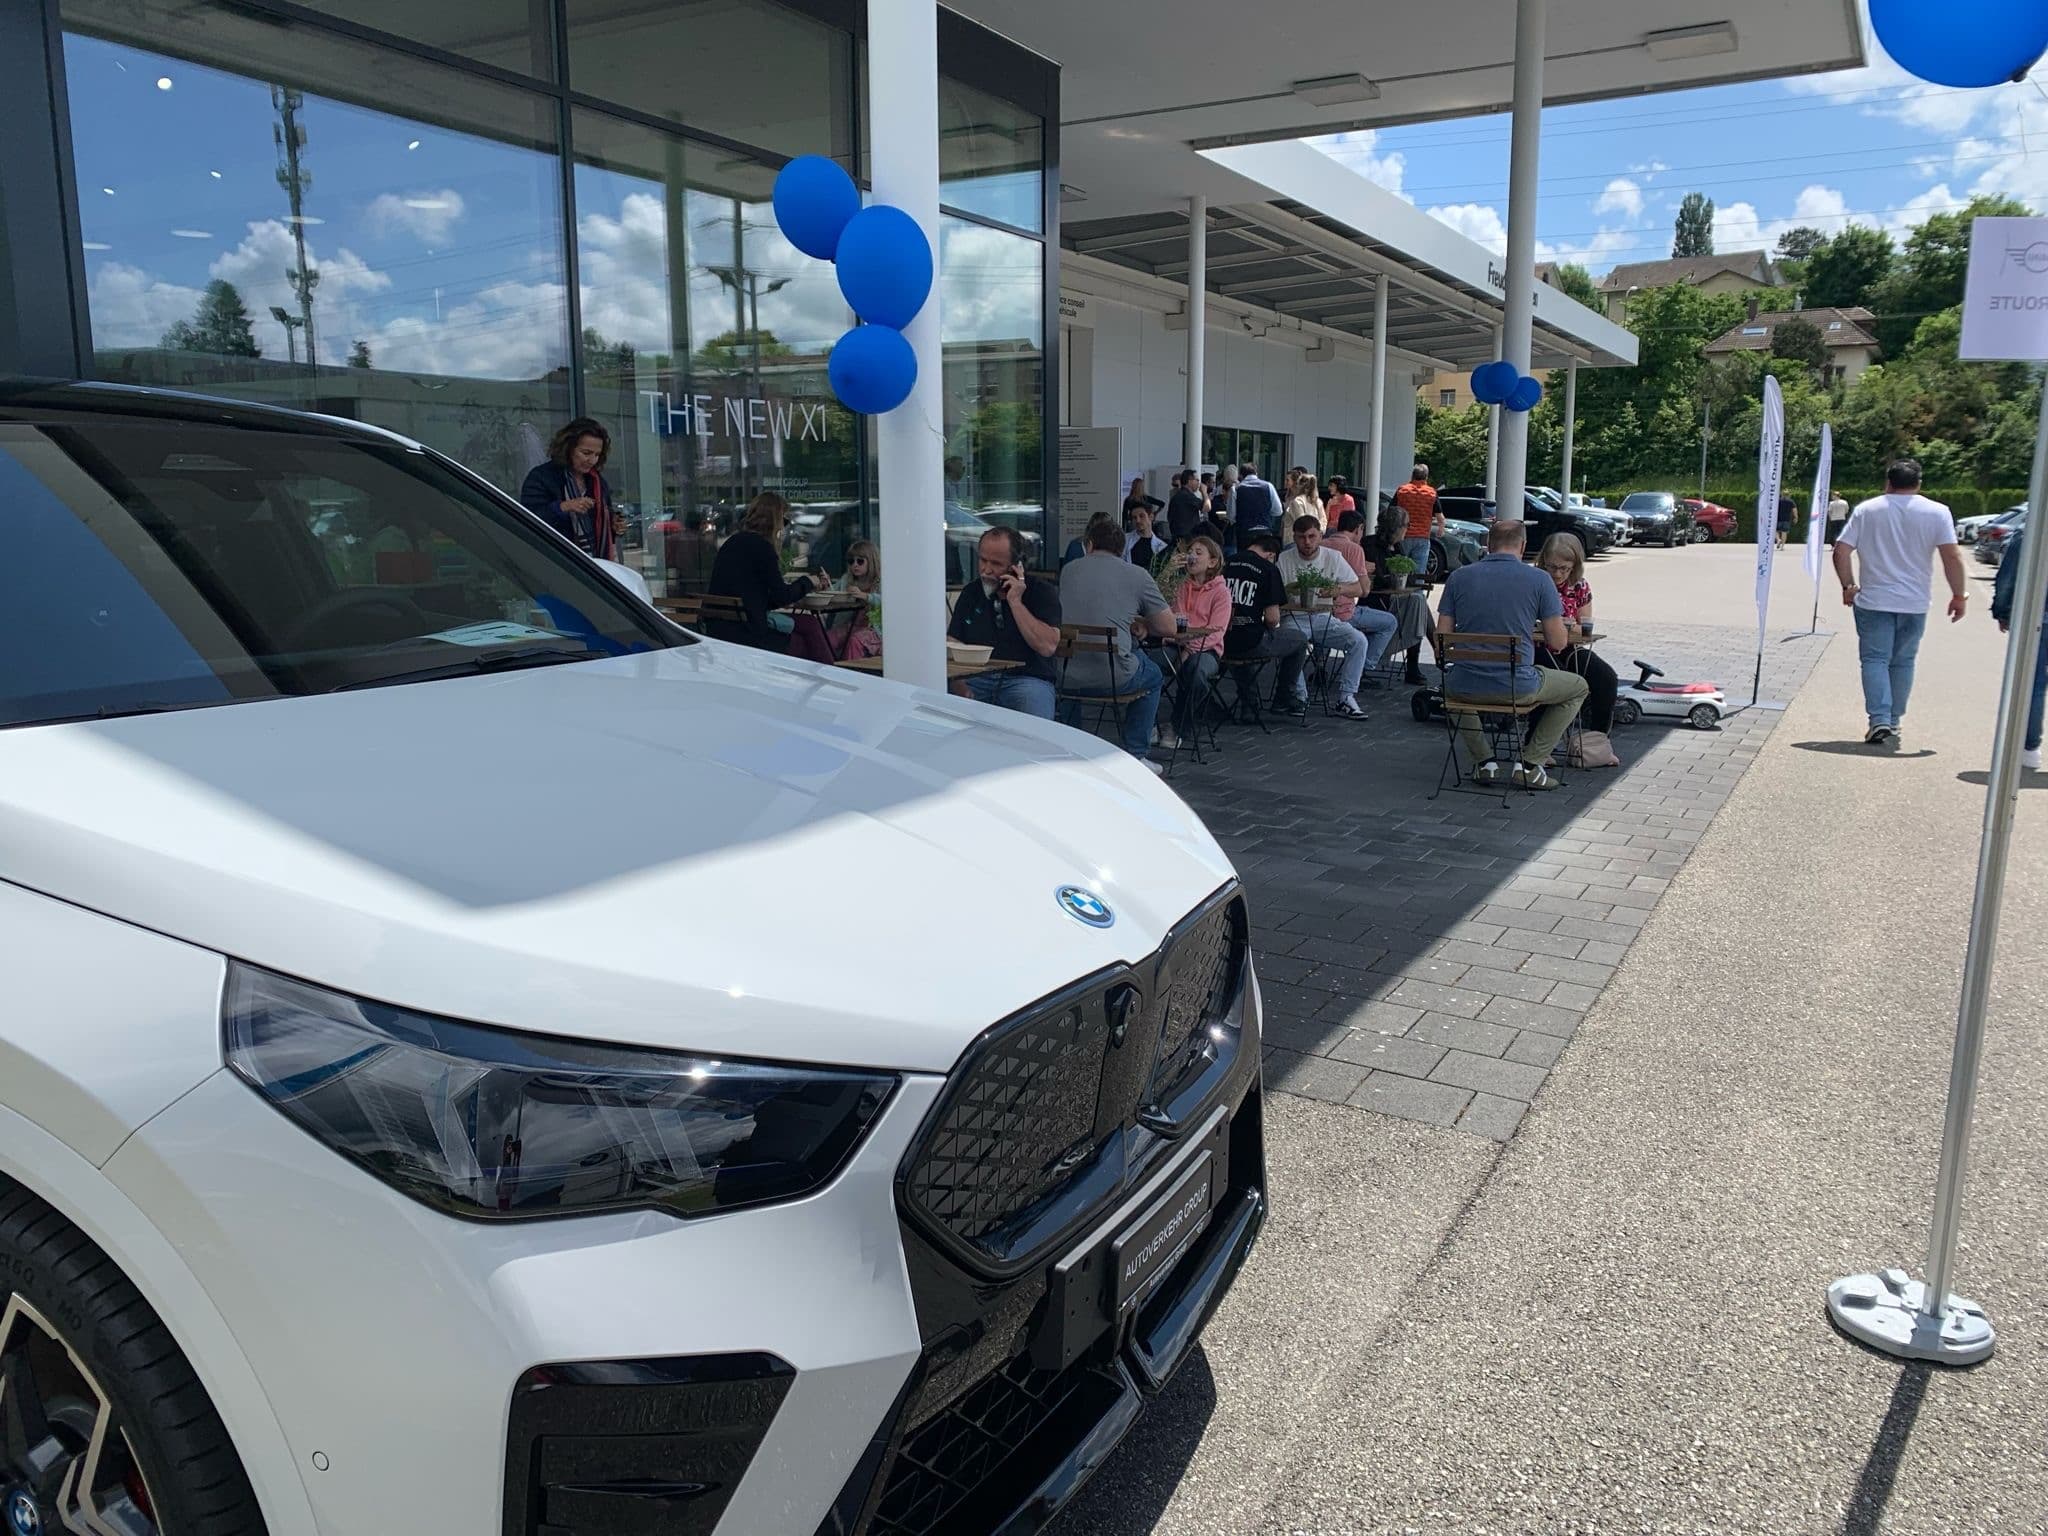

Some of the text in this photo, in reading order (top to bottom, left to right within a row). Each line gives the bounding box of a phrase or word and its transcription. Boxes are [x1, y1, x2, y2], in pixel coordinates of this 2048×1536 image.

[640, 390, 827, 442] THE NEW X1
[1125, 1182, 1208, 1282] AUTOVERKEHR GROUP
